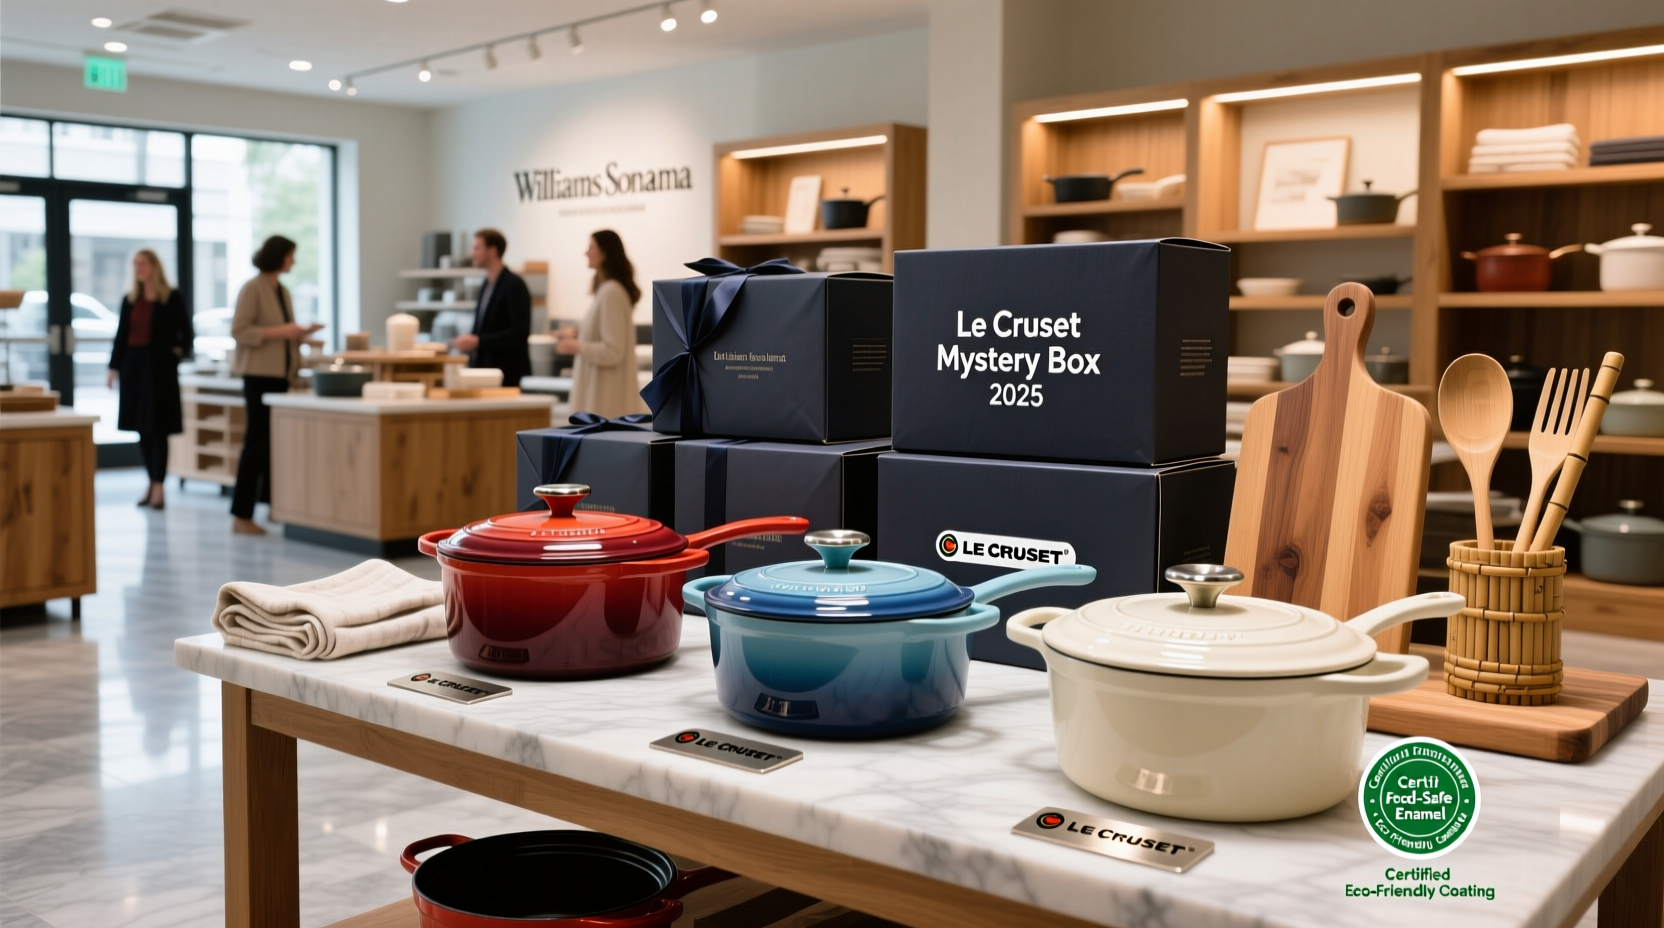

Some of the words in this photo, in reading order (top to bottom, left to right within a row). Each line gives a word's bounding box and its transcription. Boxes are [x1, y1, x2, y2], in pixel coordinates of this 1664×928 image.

[513, 169, 602, 203] Williams
[605, 161, 693, 198] Sonama
[957, 310, 987, 338] Le
[993, 309, 1082, 339] Cruset
[937, 343, 1041, 381] Mystery
[1048, 346, 1101, 375] Box
[989, 382, 1044, 407] 2025
[962, 540, 985, 556] LE
[1066, 821, 1096, 836] LE
